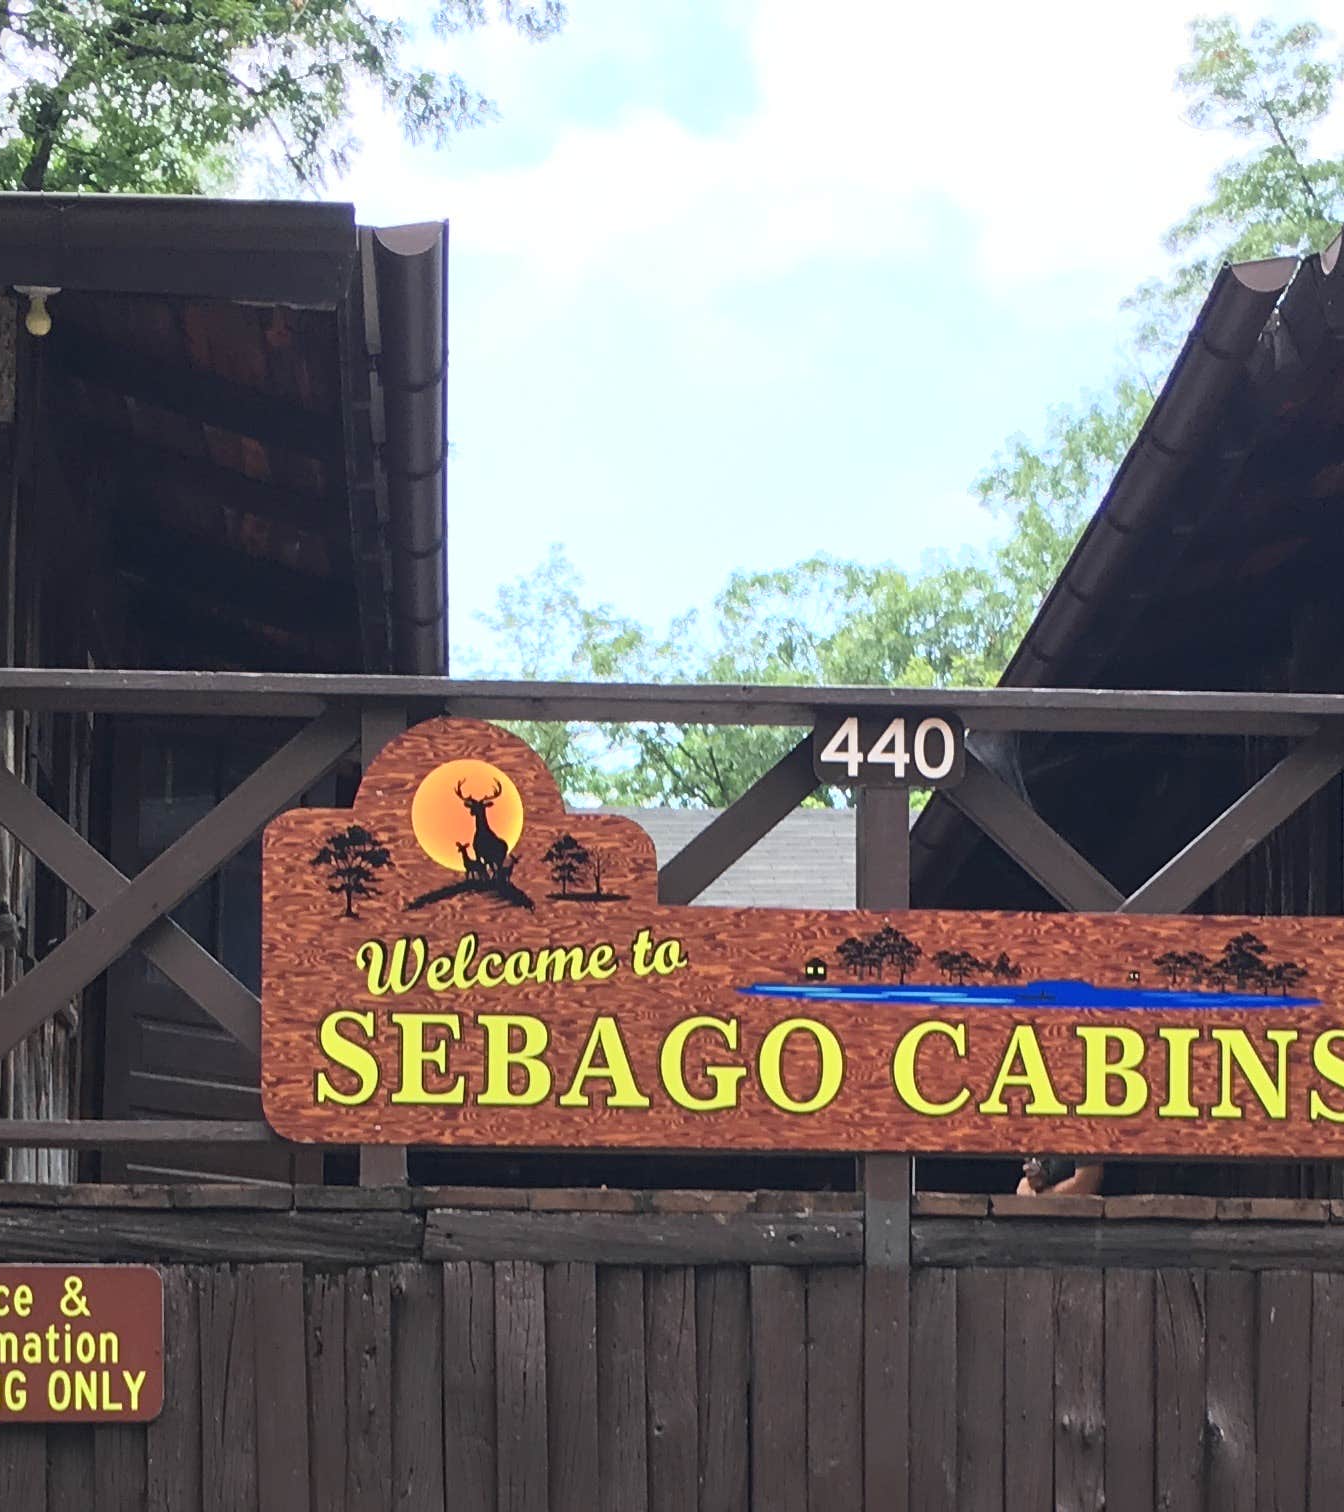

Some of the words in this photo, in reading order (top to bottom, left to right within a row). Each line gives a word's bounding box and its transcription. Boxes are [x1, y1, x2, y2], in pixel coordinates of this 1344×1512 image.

[820, 717, 955, 779] 440
[356, 933, 616, 995] Welcome
[632, 928, 687, 976] to
[316, 1010, 846, 1113] SEBAGO
[59, 1276, 91, 1317] &
[47, 1369, 147, 1412] ONLY
